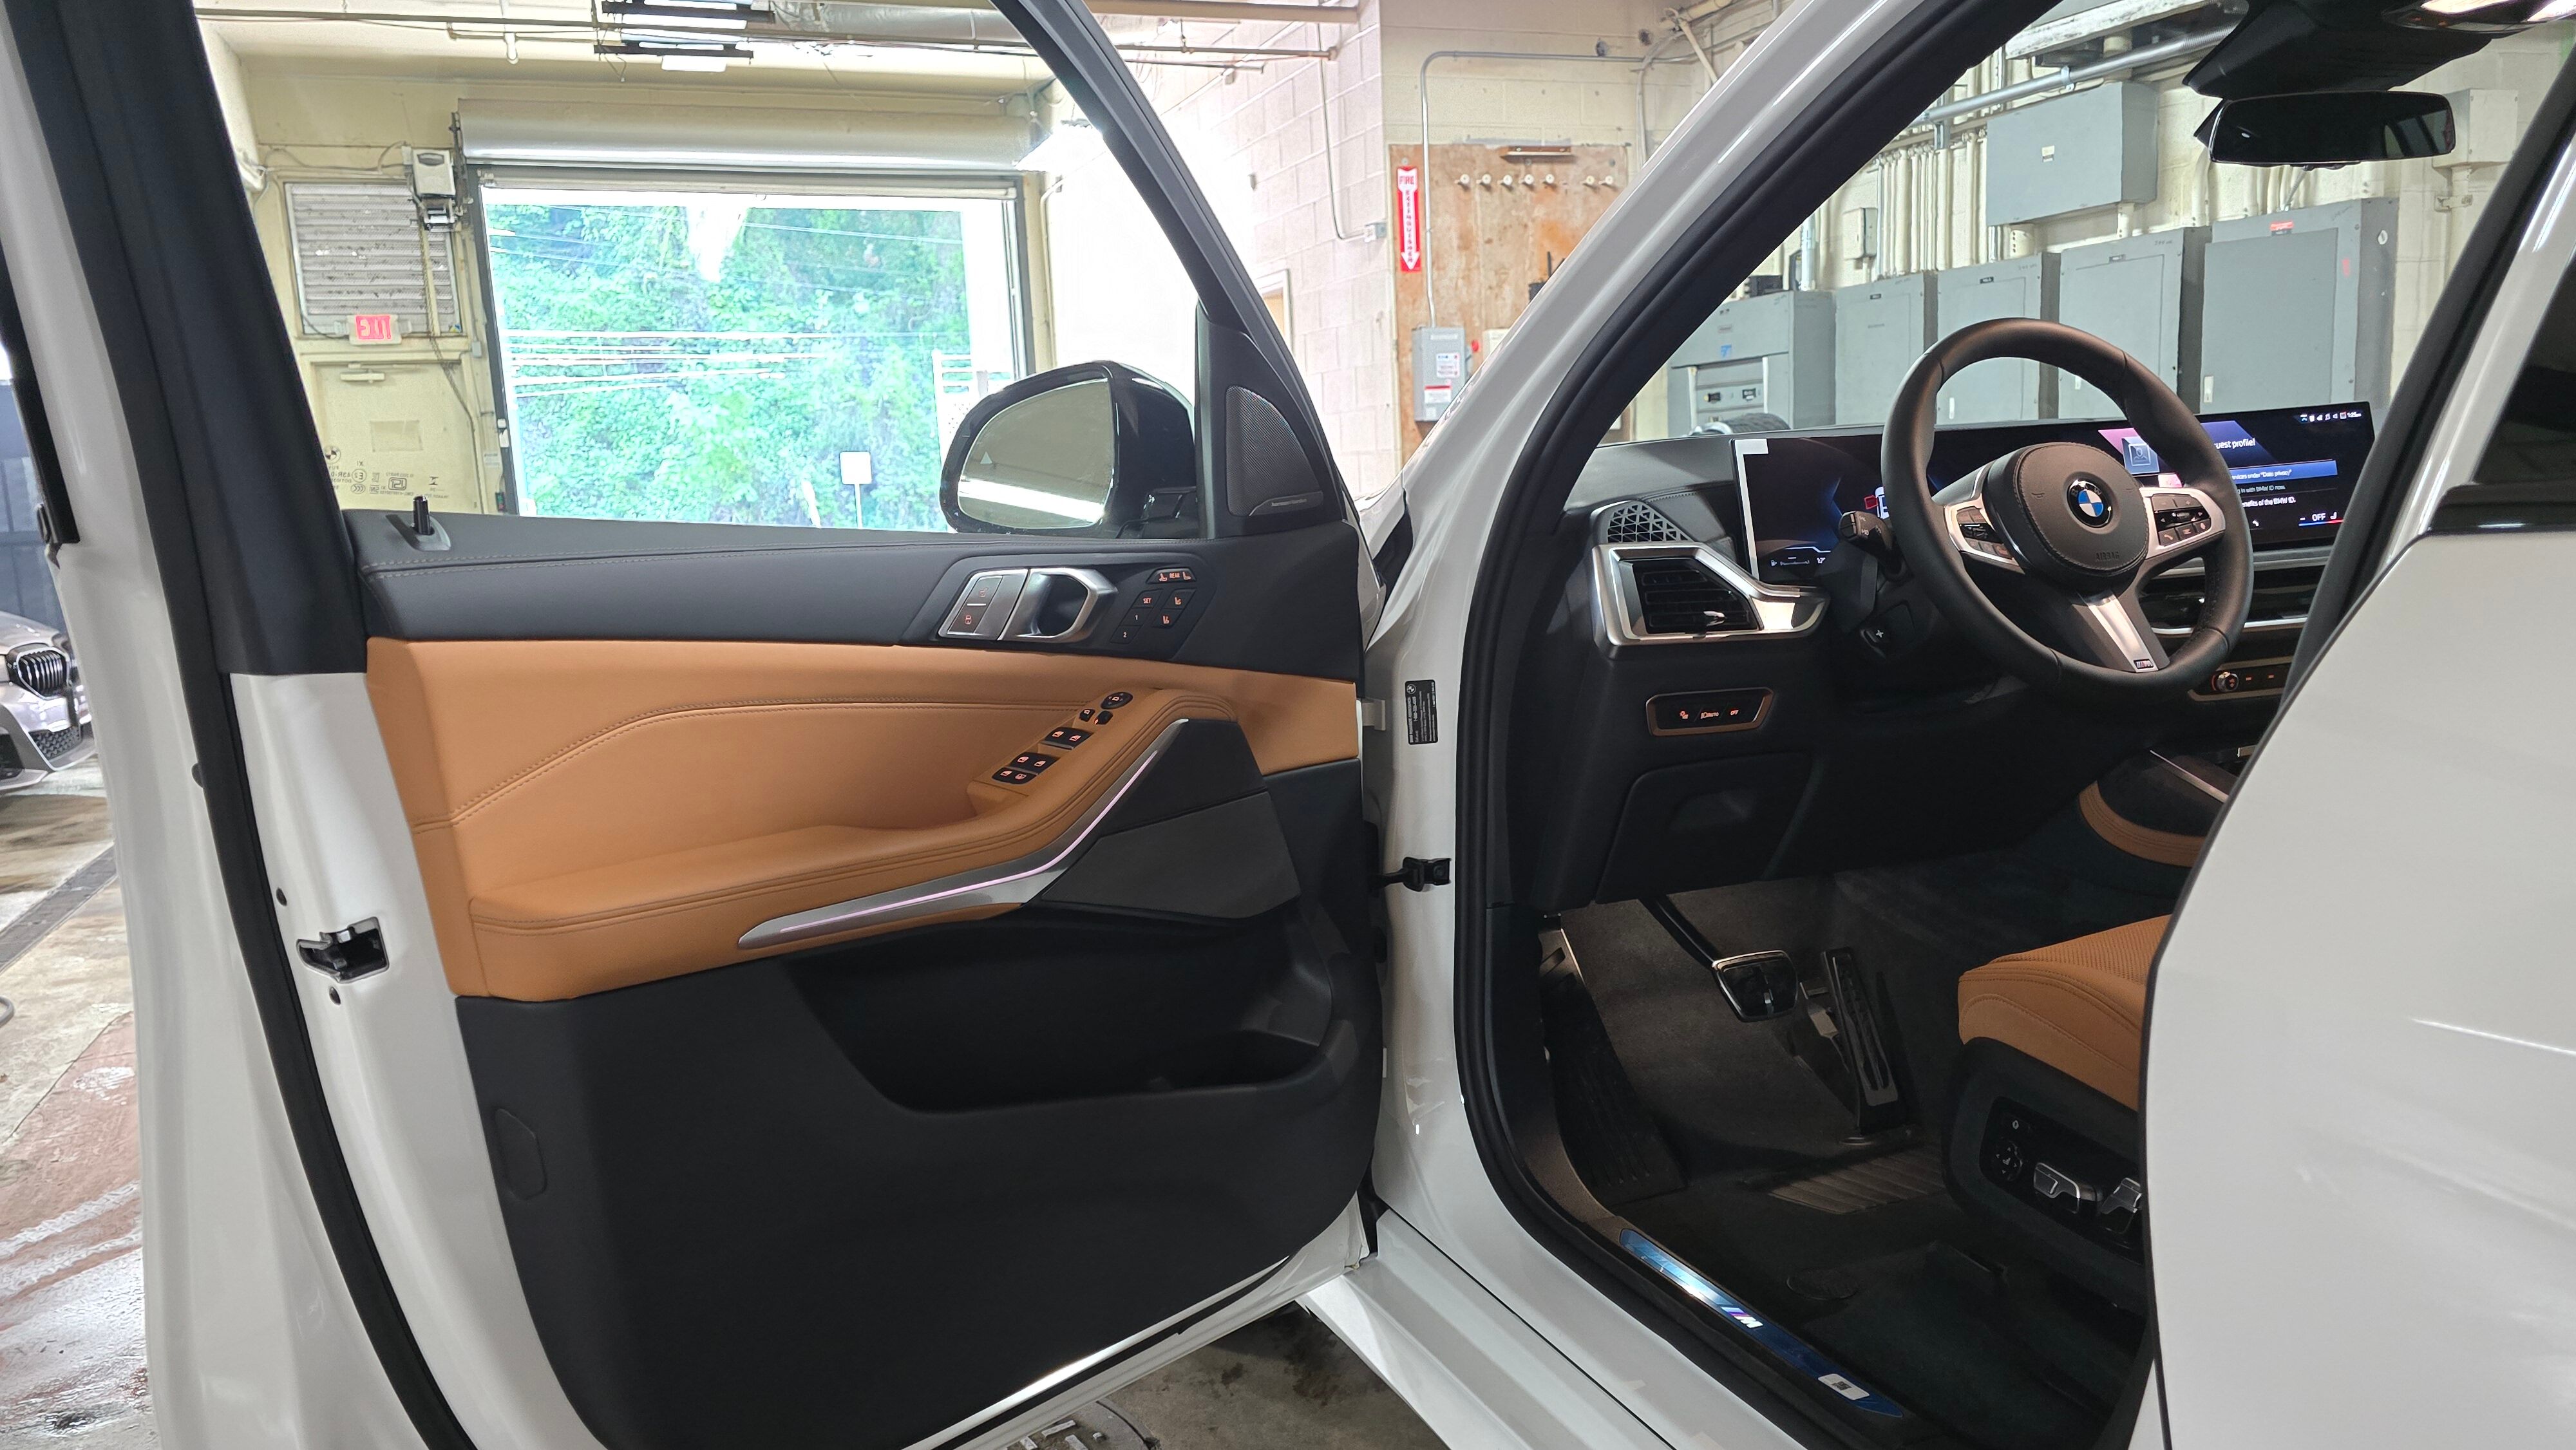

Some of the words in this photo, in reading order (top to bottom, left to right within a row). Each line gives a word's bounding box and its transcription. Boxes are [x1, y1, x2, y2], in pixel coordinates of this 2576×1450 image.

[1399, 176, 1414, 185] FIRE
[2273, 496, 2287, 505] BMW
[2312, 513, 2325, 521] OFF
[2096, 552, 2119, 562] AIRBAG
